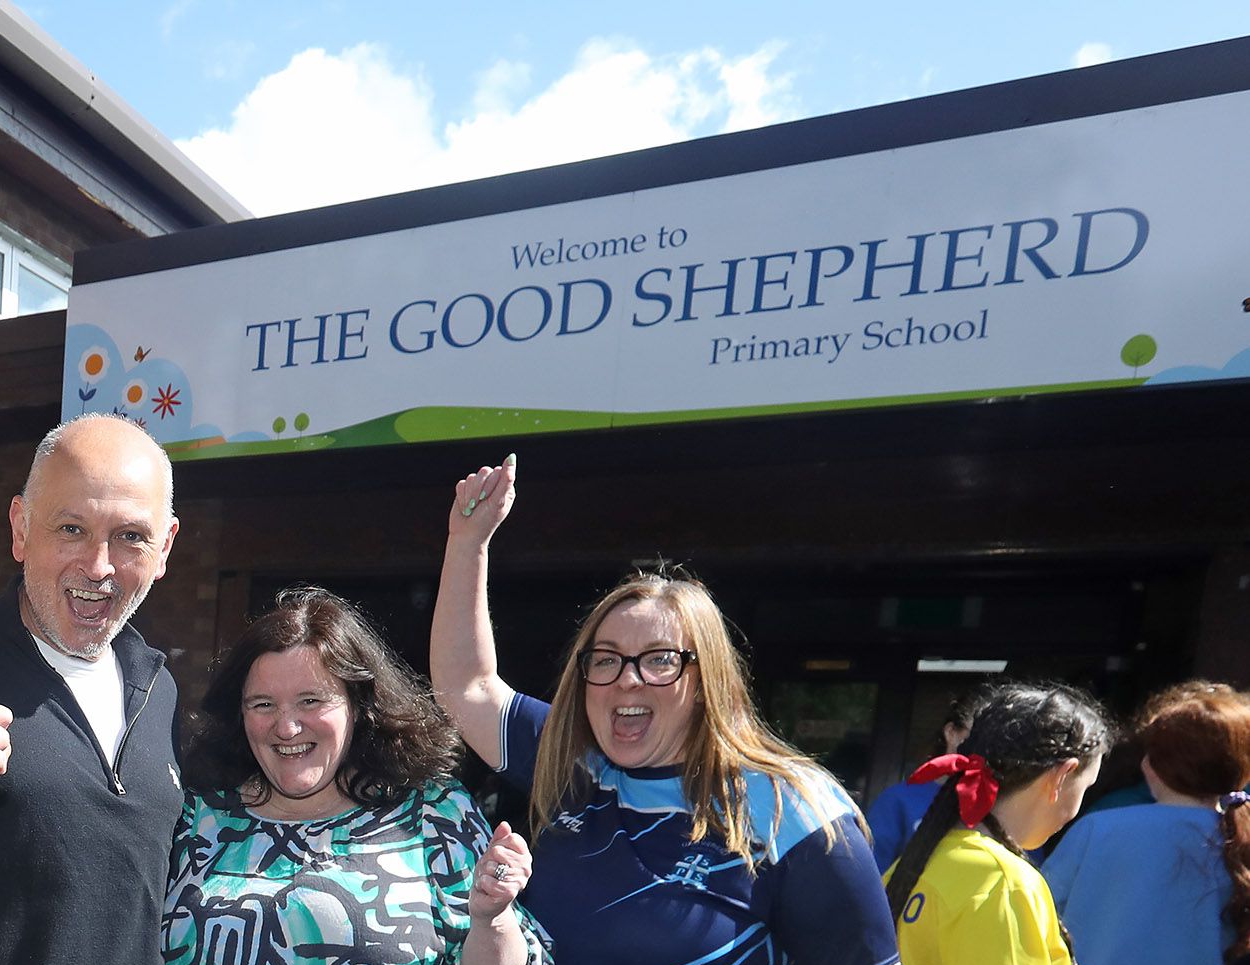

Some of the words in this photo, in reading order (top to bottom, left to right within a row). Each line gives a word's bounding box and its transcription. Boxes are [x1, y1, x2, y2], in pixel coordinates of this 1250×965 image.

[511, 234, 647, 271] Welcome
[656, 225, 688, 250] to
[245, 308, 371, 372] THE
[388, 278, 613, 355] GOOD
[631, 207, 1150, 328] SHEPHERD
[709, 328, 854, 366] Primary
[860, 308, 989, 351] School
